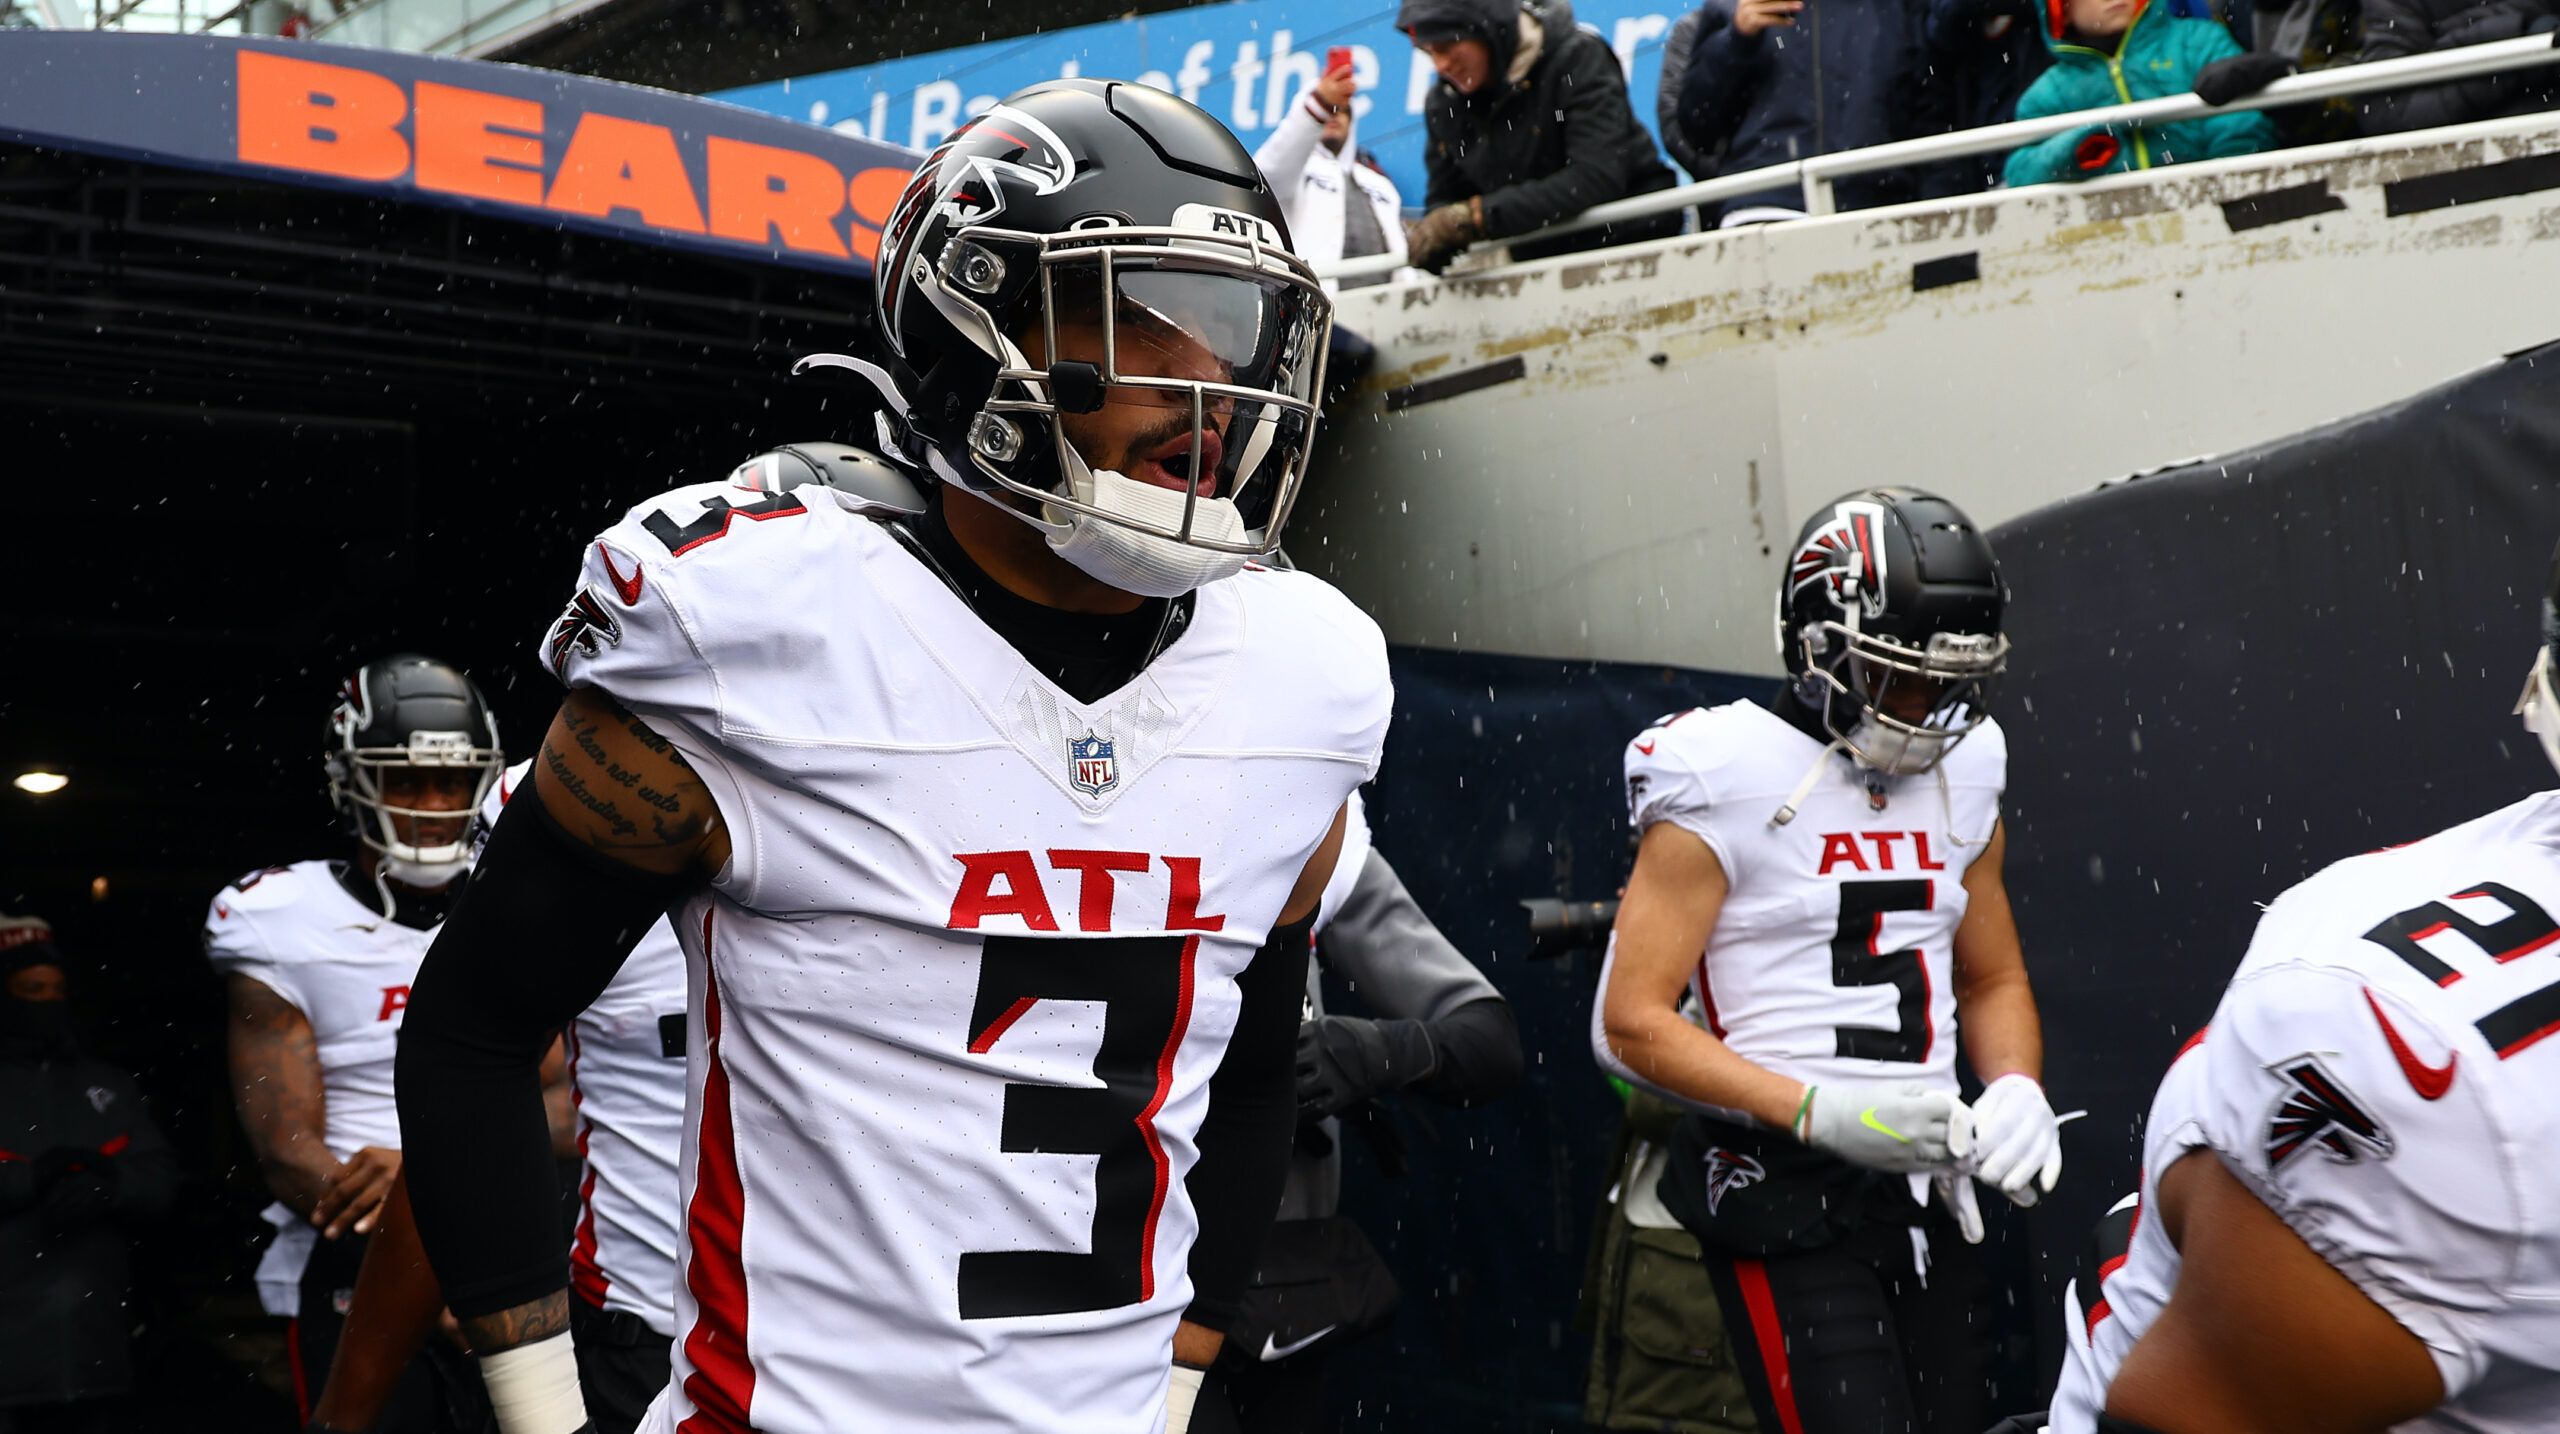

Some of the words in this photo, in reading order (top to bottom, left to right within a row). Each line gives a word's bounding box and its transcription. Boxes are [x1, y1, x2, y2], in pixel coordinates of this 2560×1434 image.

[1212, 211, 1270, 245] ATL
[576, 724, 607, 766] lean
[606, 762, 642, 788] not
[1077, 760, 1113, 786] NFL
[1818, 831, 1946, 875] ATL
[946, 848, 1226, 932] ATL
[1831, 878, 1935, 1064] 5
[957, 932, 1200, 1321] 3
